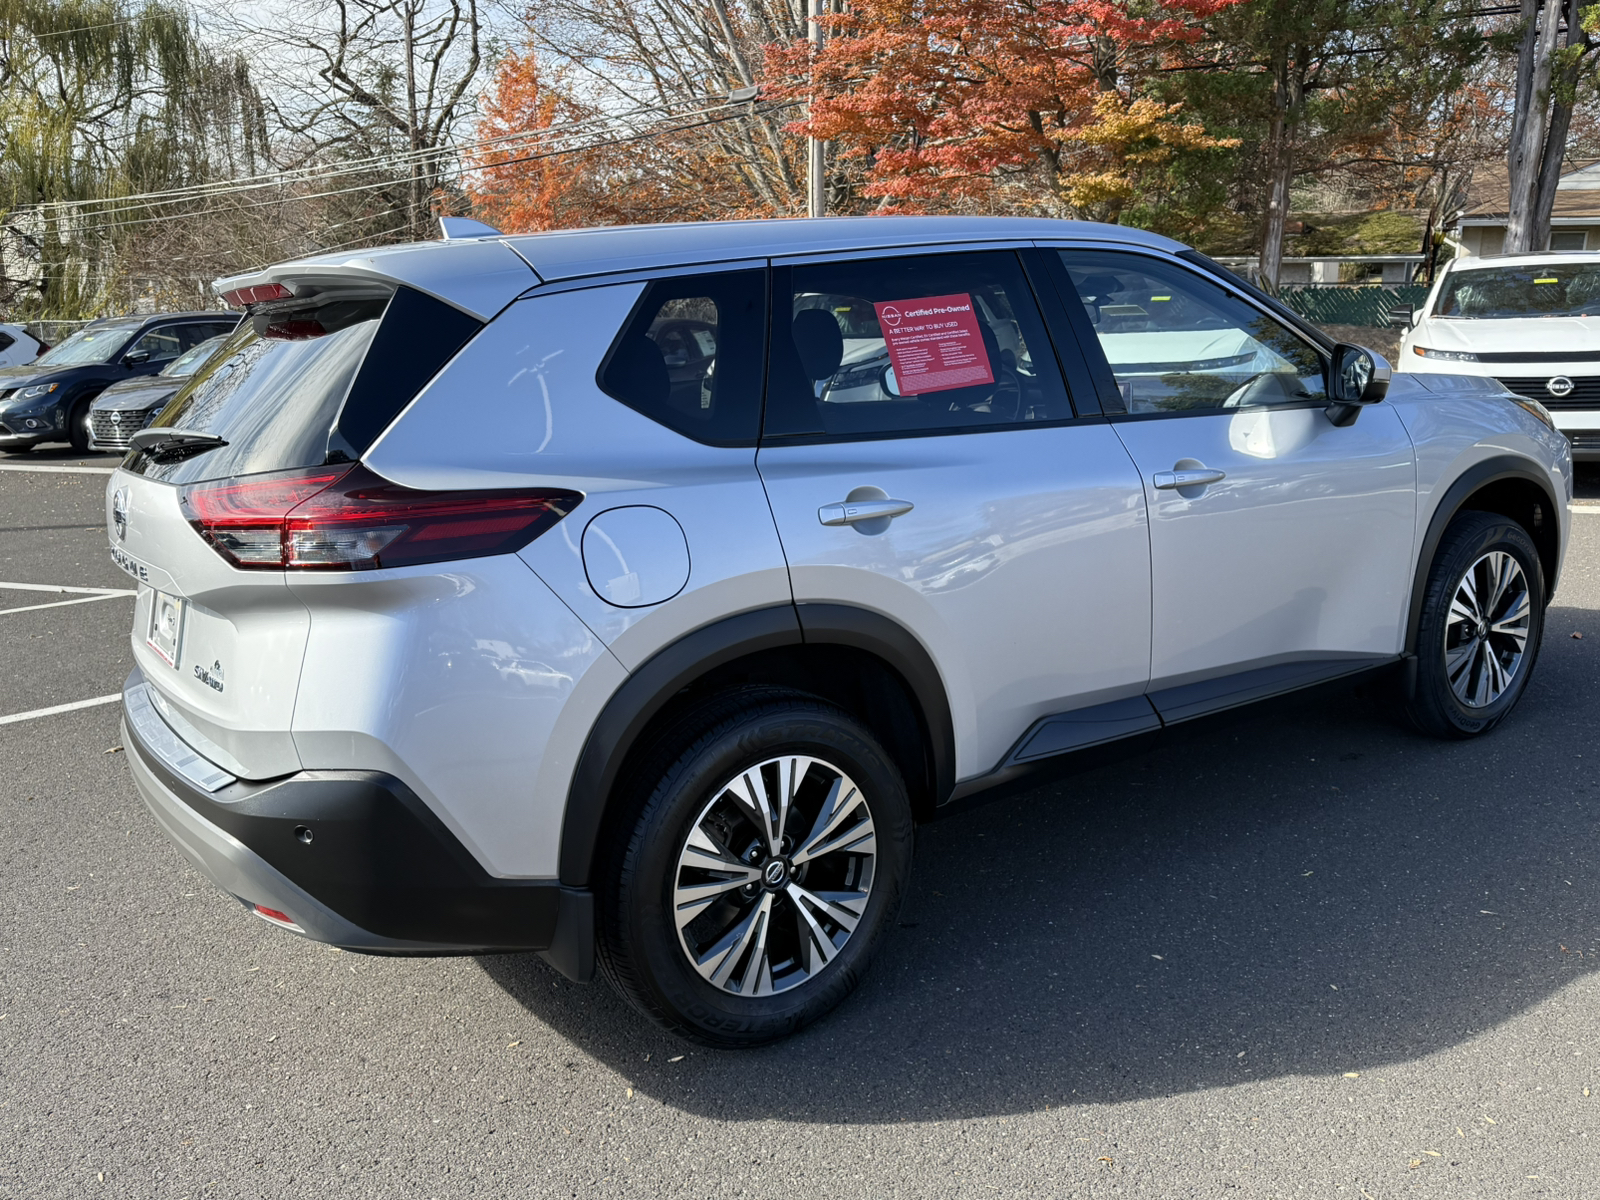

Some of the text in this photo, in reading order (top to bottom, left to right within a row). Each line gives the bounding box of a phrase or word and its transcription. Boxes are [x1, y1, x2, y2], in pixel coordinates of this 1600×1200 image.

[905, 304, 970, 317] Certified Pre-Owned
[1546, 382, 1575, 390] NISSAN
